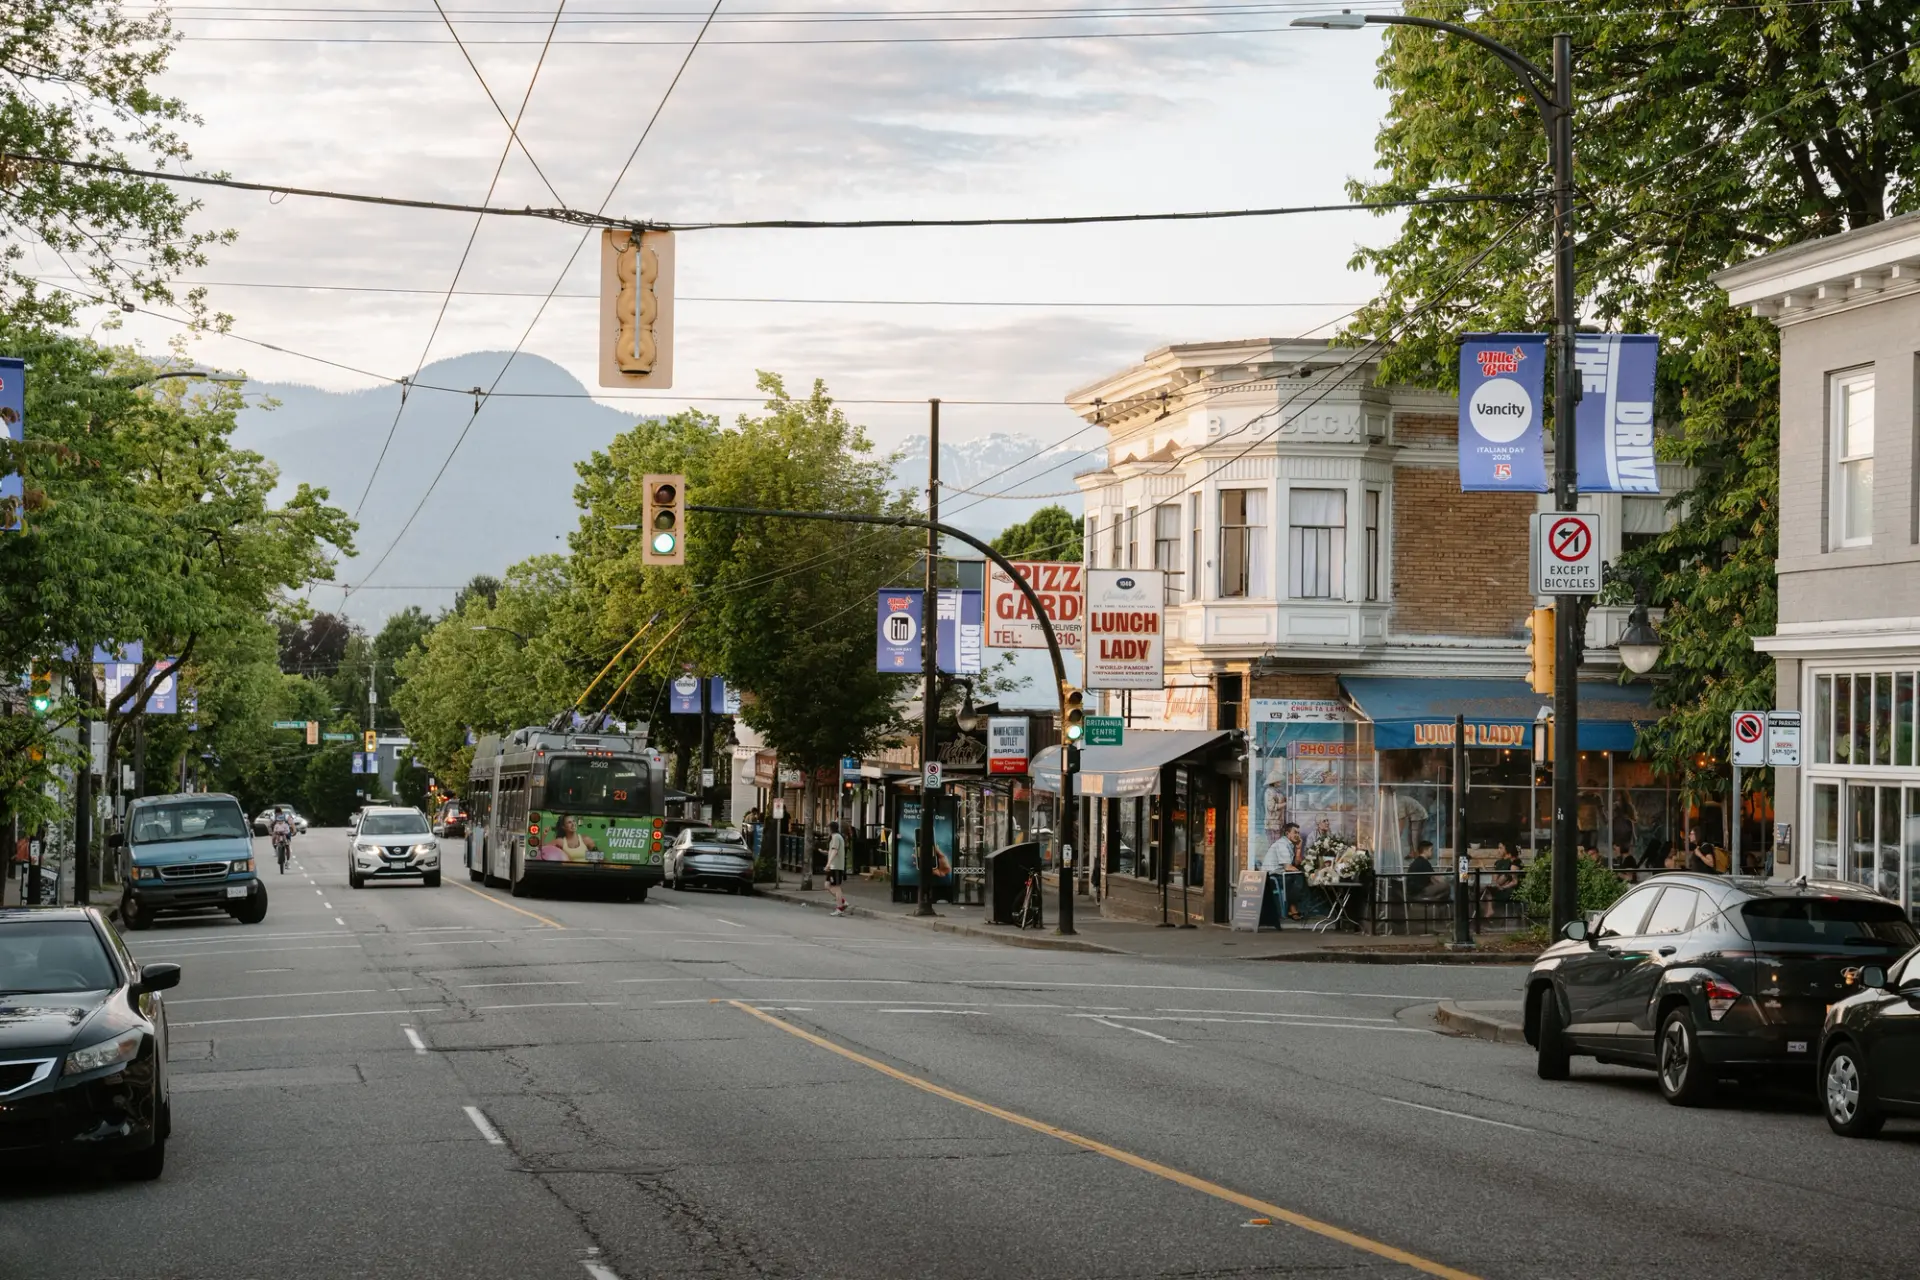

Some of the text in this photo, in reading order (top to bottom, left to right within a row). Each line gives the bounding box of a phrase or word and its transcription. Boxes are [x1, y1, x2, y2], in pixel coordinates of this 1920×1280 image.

[1477, 350, 1514, 364] Mille
[1482, 362, 1518, 376] Baci
[1476, 403, 1525, 418] Vancity
[1616, 402, 1658, 491] DRIVE
[1550, 565, 1589, 575] EXCEPT
[1545, 578, 1595, 588] BICYCLES
[1091, 612, 1159, 635] LUNCH
[994, 631, 1022, 644] TEL:
[1100, 639, 1151, 662] LADY
[1086, 719, 1122, 727] BRITANNIA
[1091, 728, 1116, 736] CENTRE
[1414, 724, 1525, 746] LUNCH LADY
[1000, 736, 1018, 746] OUTLET
[613, 790, 627, 800] 20
[606, 828, 649, 838] FITNESS
[608, 838, 645, 849] WORLD
